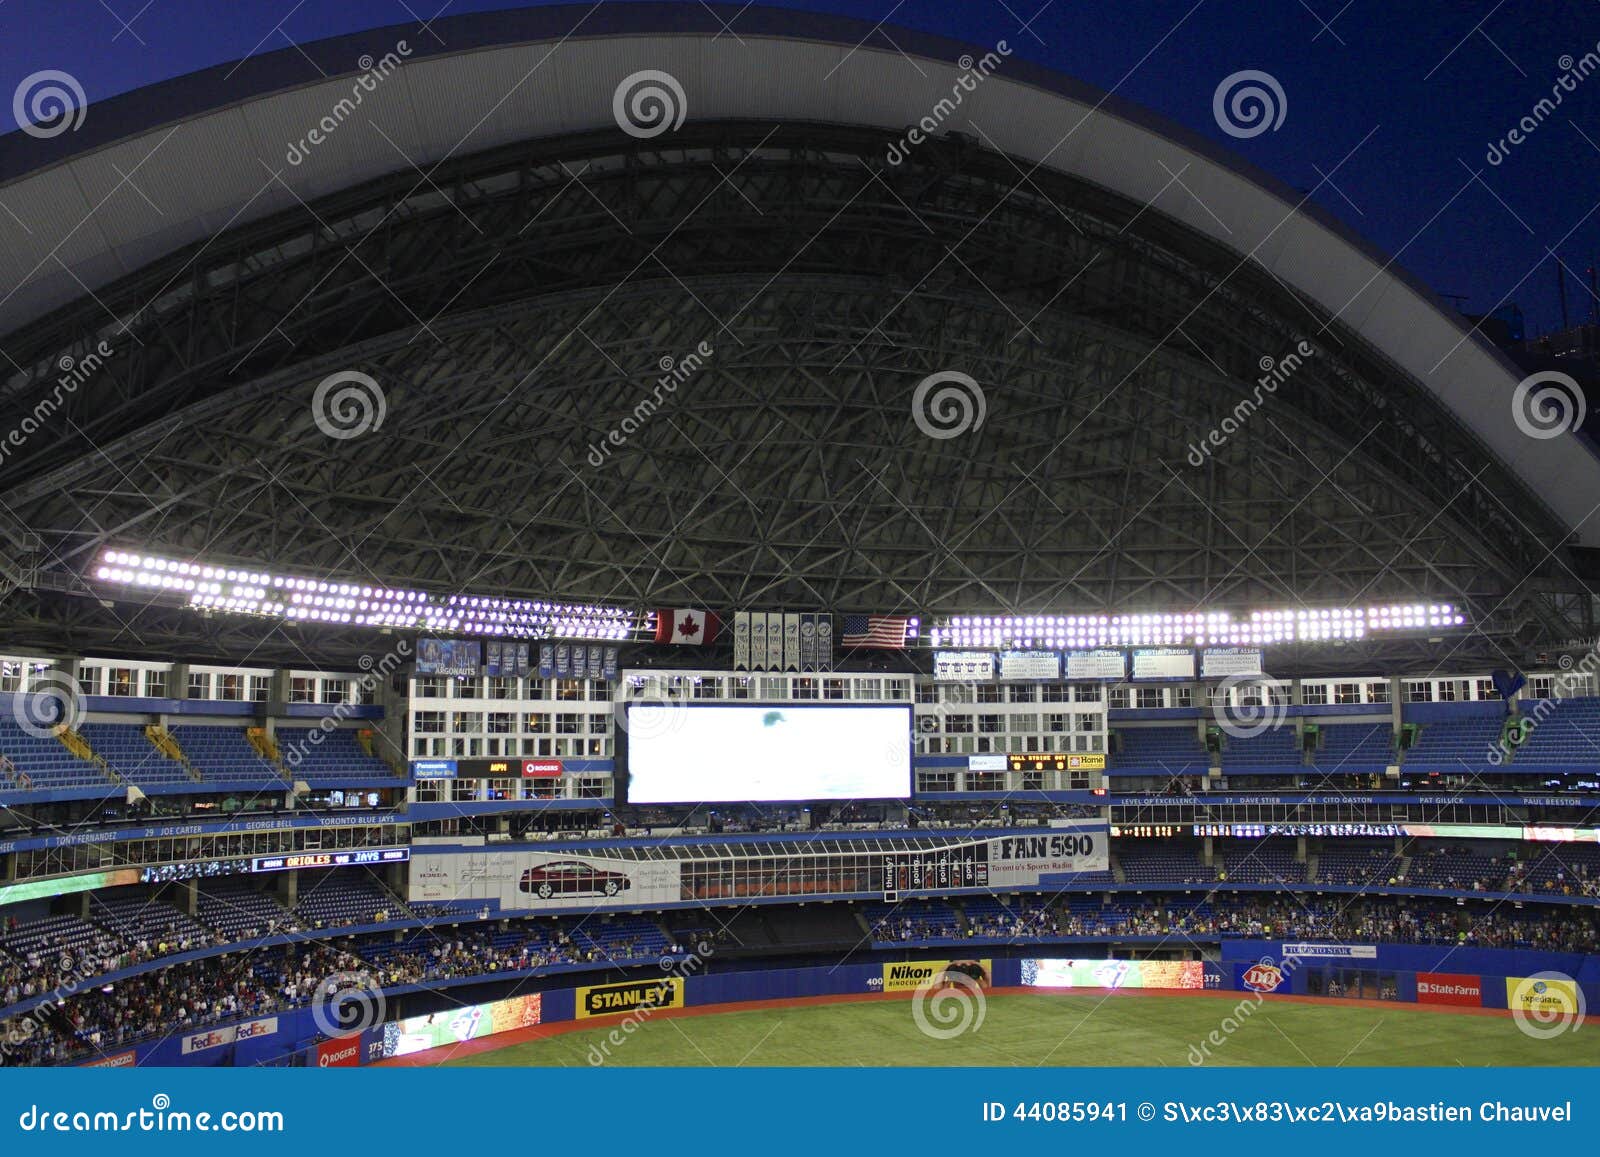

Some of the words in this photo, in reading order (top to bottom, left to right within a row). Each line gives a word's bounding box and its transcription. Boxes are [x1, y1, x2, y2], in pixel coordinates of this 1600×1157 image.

[1322, 796, 1341, 804] CITO
[1523, 798, 1543, 806] PAUL
[246, 820, 275, 830] GEORGE
[276, 819, 293, 829] BELL
[320, 816, 356, 826] TORONTO
[358, 814, 377, 824] BLUE
[145, 828, 154, 837] 29
[160, 826, 175, 836] JOE
[176, 825, 202, 835] CARTER
[77, 831, 117, 844] FERNANDEZ
[1001, 836, 1048, 860] FAN
[1050, 834, 1094, 858] 590
[287, 855, 330, 868] ORIOLES
[355, 852, 380, 862] JAYS
[1026, 863, 1050, 871] Sports
[890, 966, 933, 980] Nikon
[1204, 974, 1221, 983] 375
[867, 977, 883, 986] 400
[591, 986, 668, 1010] STANLEY
[235, 1022, 269, 1039] FedEx
[191, 1031, 223, 1051] FedEx
[329, 1046, 357, 1063] ROGERS
